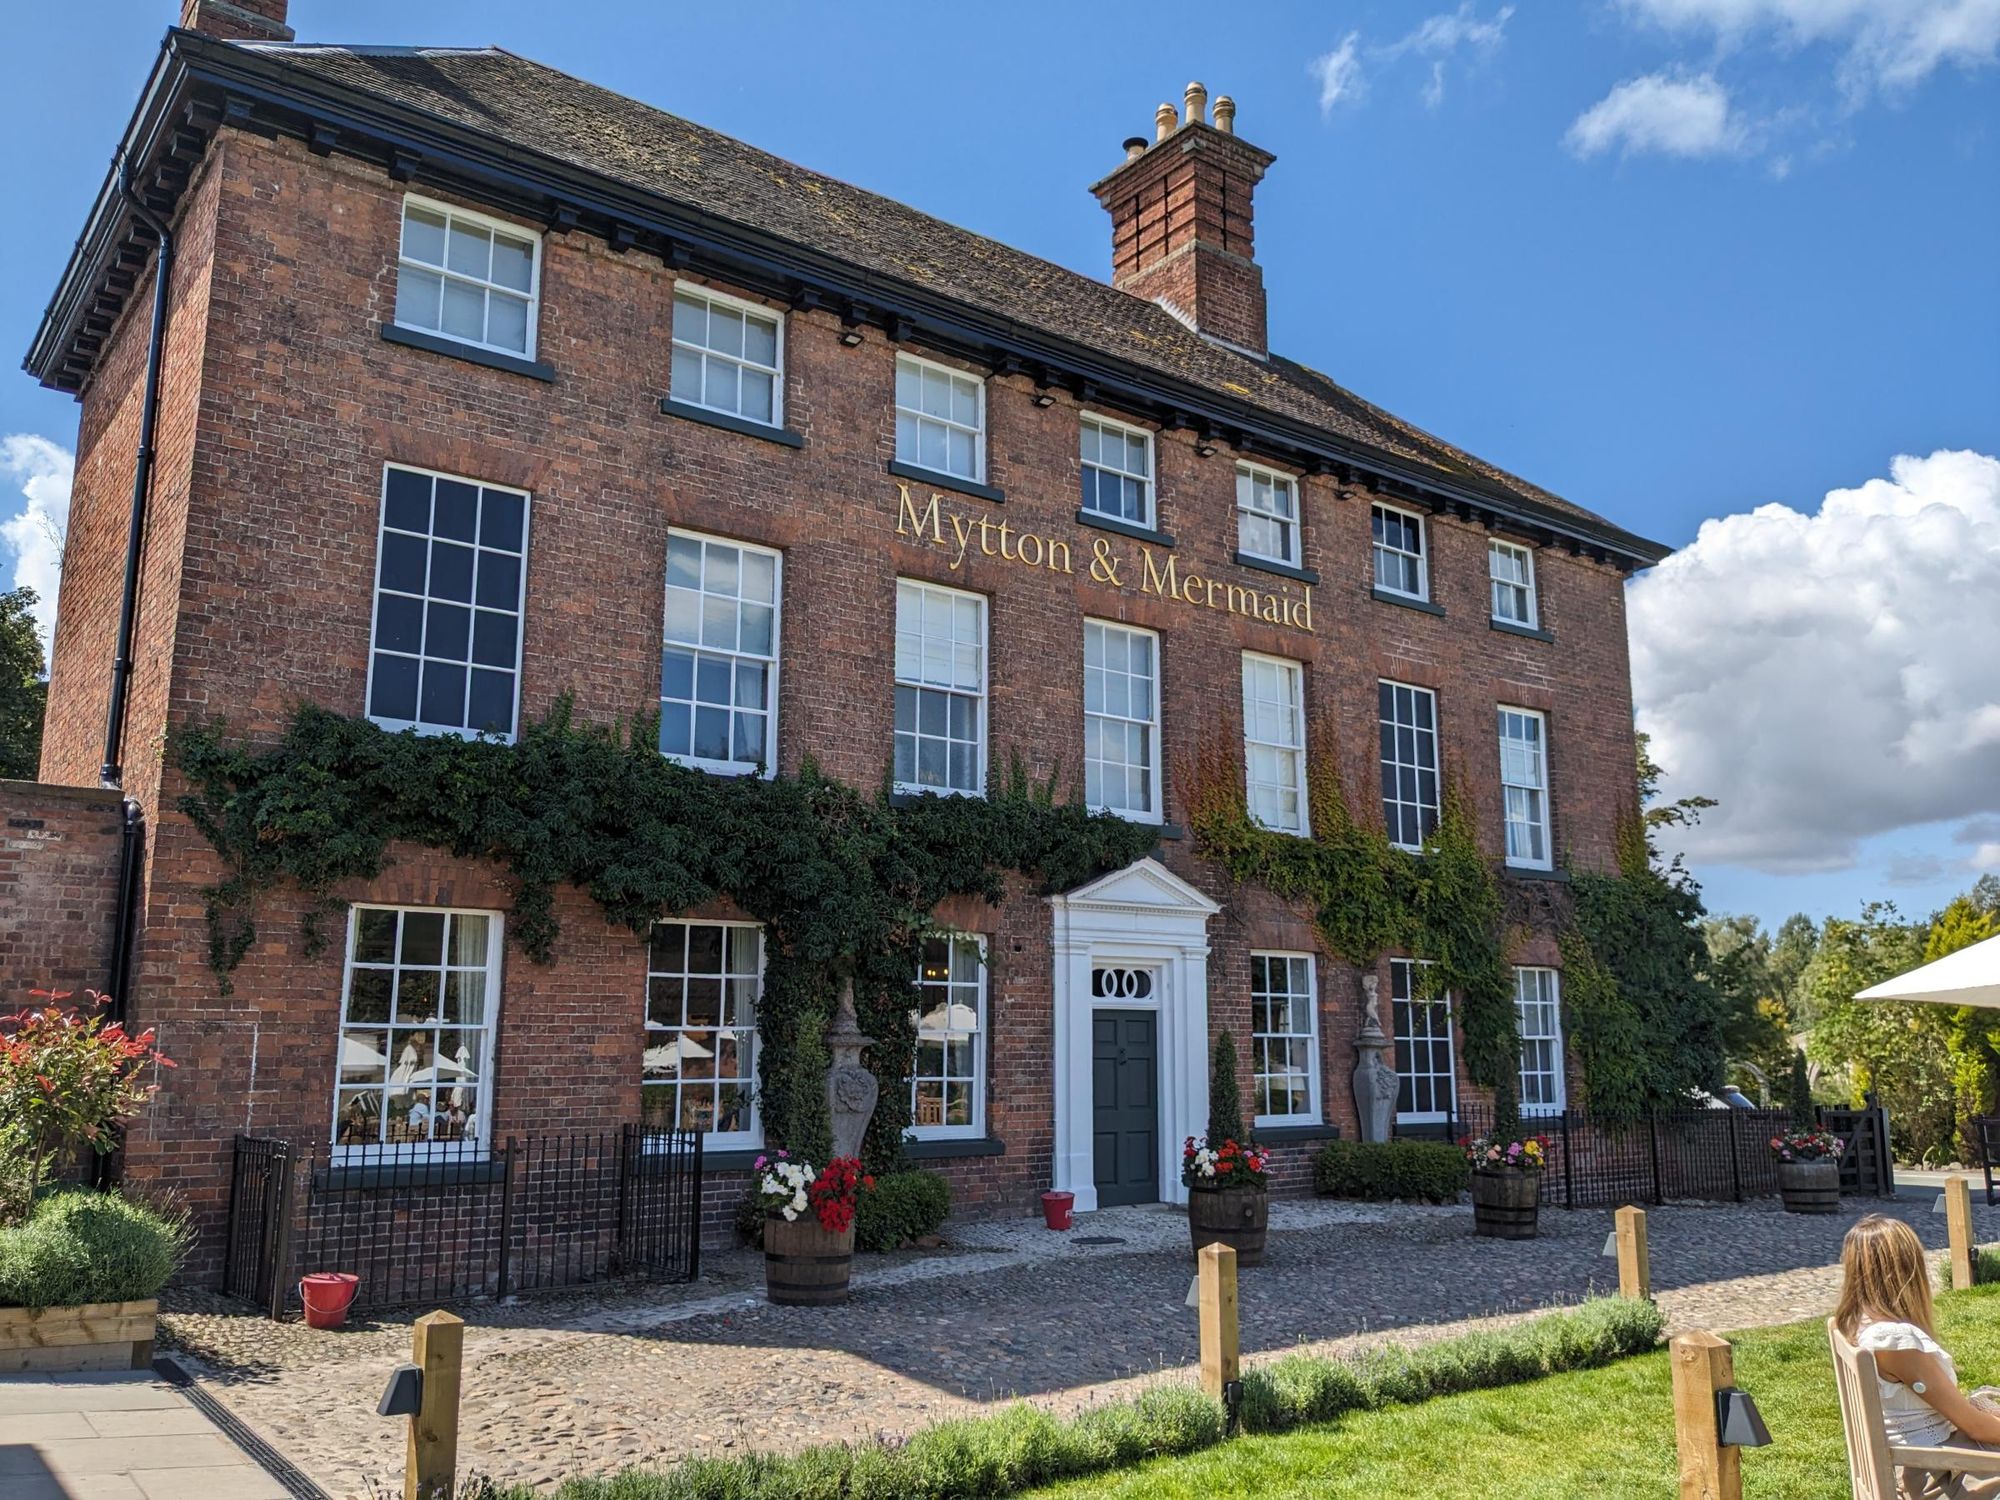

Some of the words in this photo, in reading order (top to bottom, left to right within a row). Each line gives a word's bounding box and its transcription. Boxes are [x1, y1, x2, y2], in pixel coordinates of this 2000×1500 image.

[895, 483, 1073, 571] Mytton
[1089, 538, 1124, 587] &
[1140, 545, 1315, 632] Mermaid
